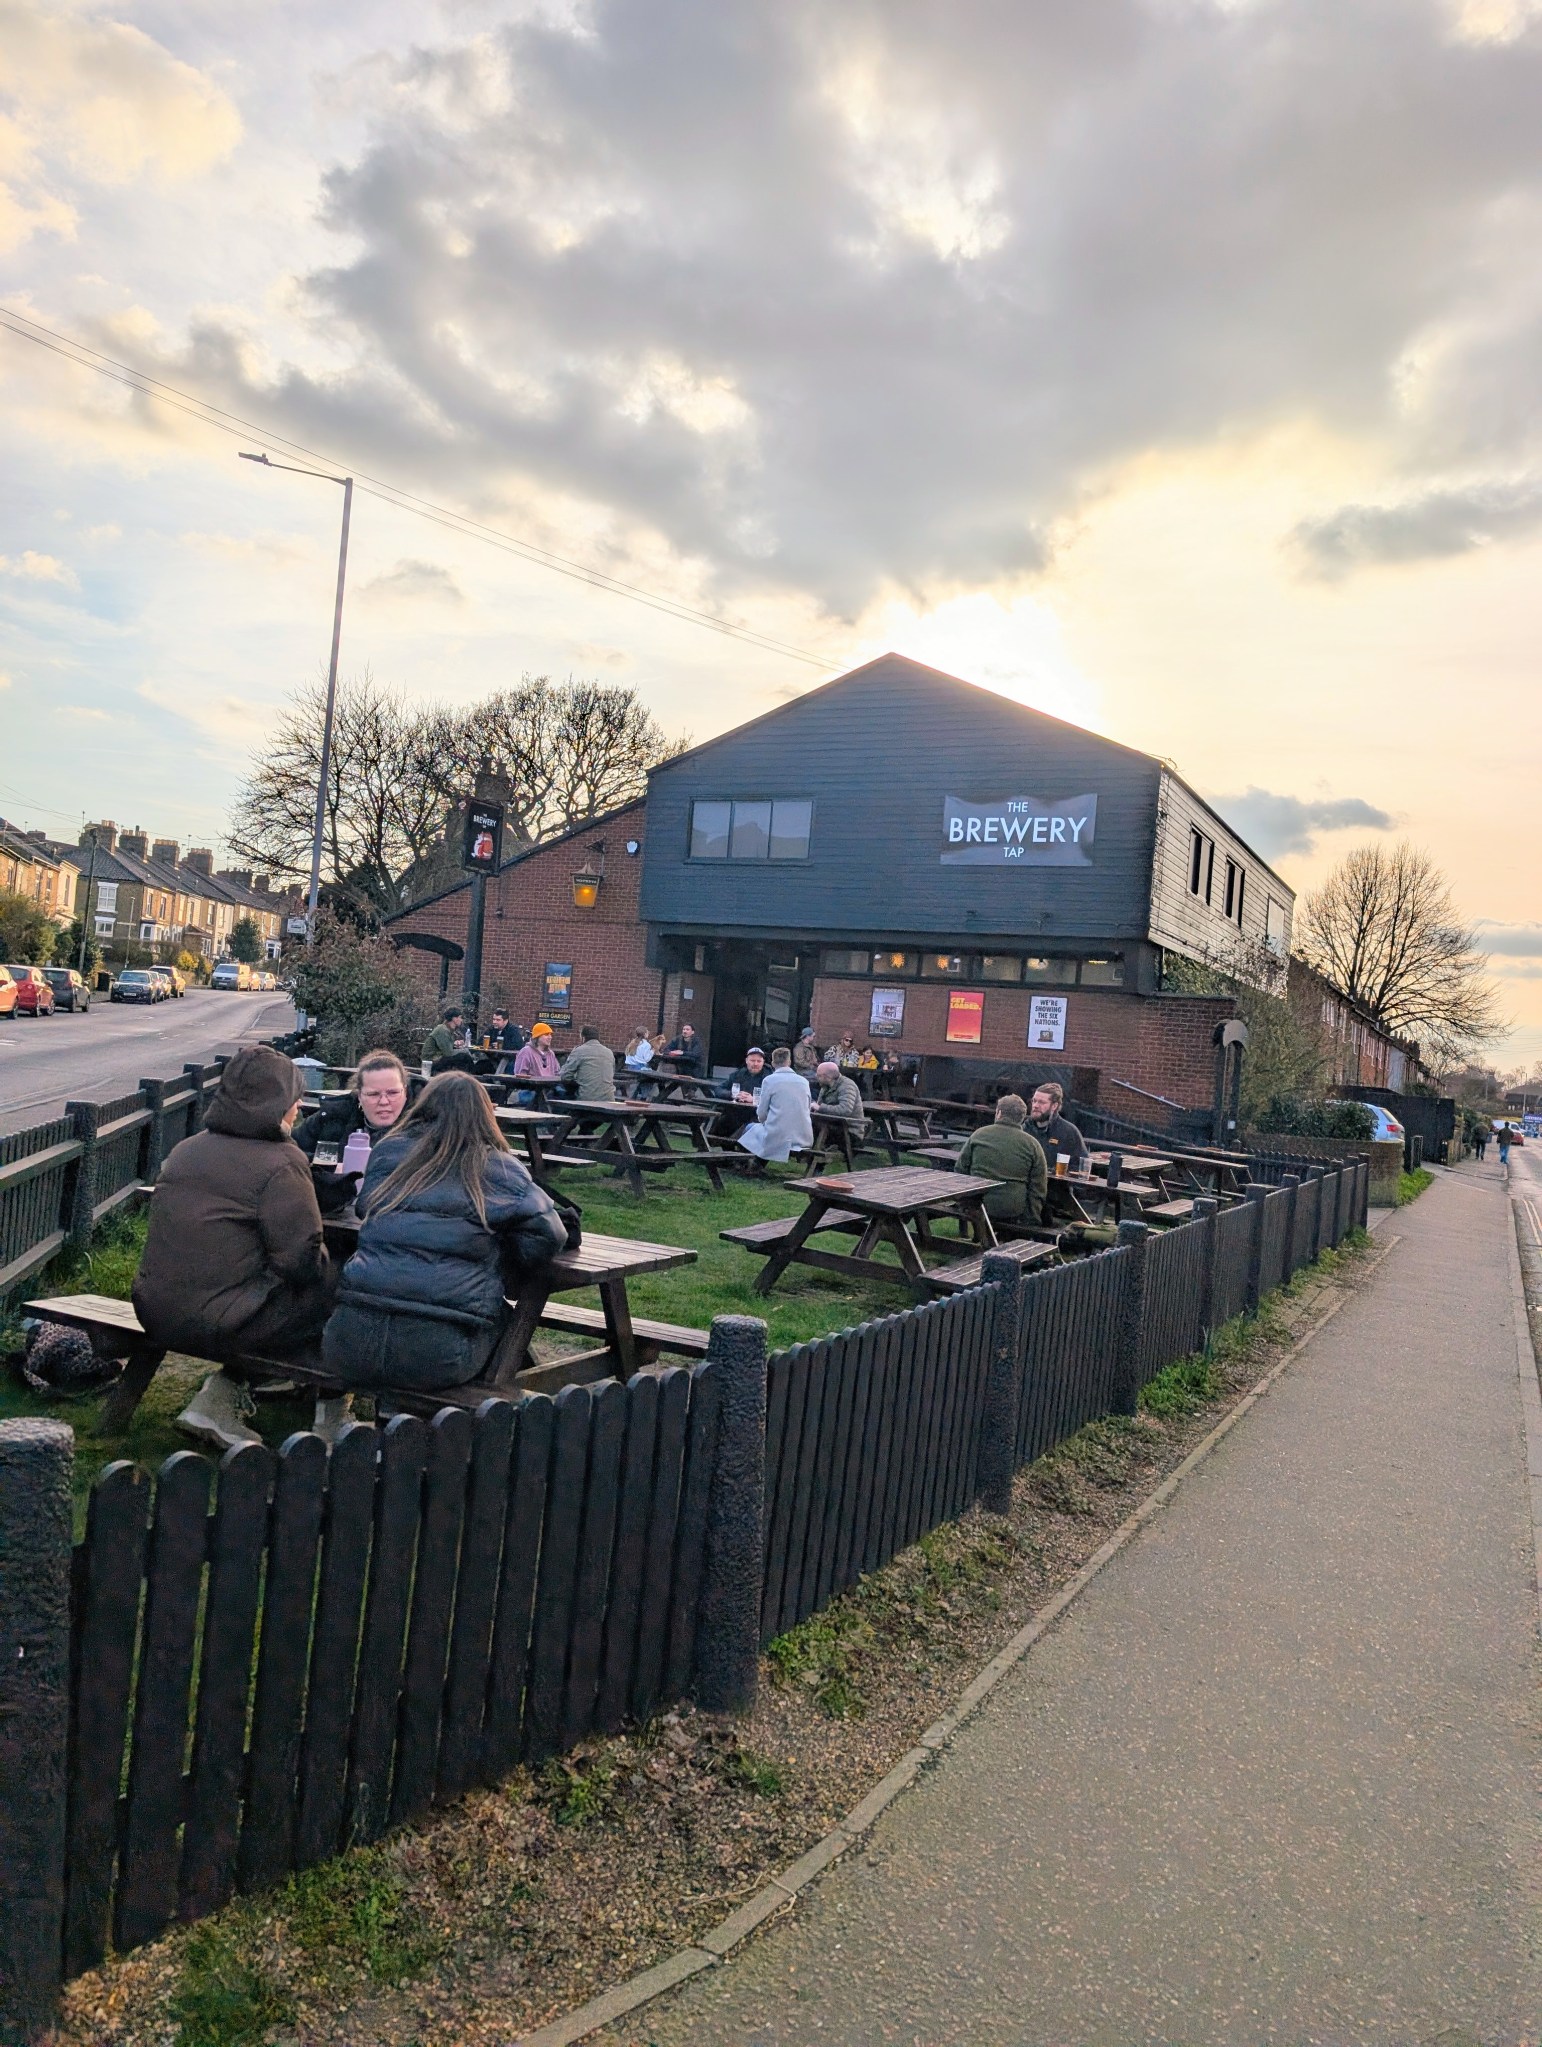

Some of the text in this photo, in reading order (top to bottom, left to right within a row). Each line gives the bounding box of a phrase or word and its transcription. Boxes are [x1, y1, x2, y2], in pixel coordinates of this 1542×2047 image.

[1007, 802, 1029, 813] THE
[473, 814, 497, 828] BREWERY
[949, 817, 1088, 844] BREWERY
[1003, 847, 1025, 858] TAP
